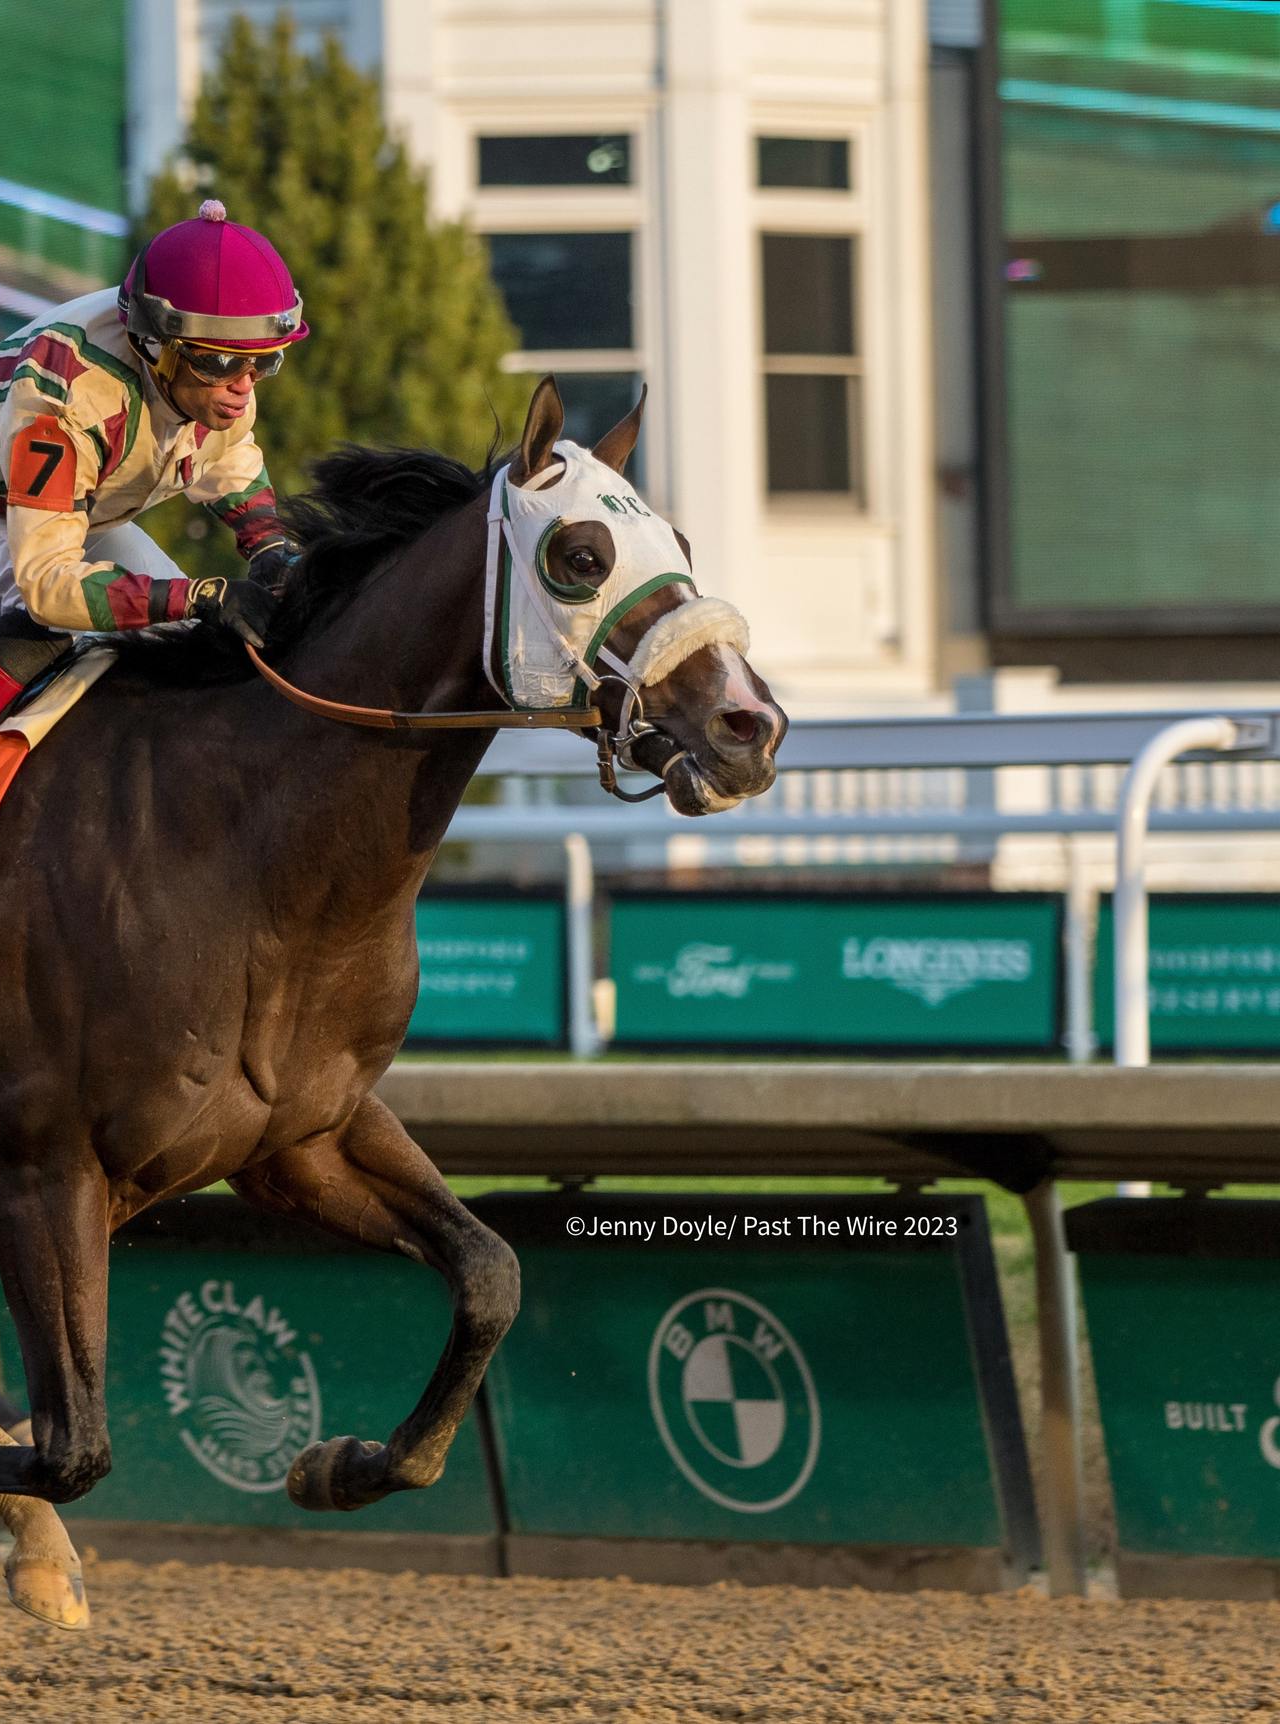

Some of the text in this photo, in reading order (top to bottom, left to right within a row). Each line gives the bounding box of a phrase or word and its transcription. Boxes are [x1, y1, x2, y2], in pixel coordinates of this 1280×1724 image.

[27, 440, 65, 497] 7
[841, 936, 1033, 982] LONGINES
[160, 1280, 298, 1416] WHITE CLAW
[662, 1302, 787, 1361] BMW
[1164, 1400, 1248, 1432] BUILT
